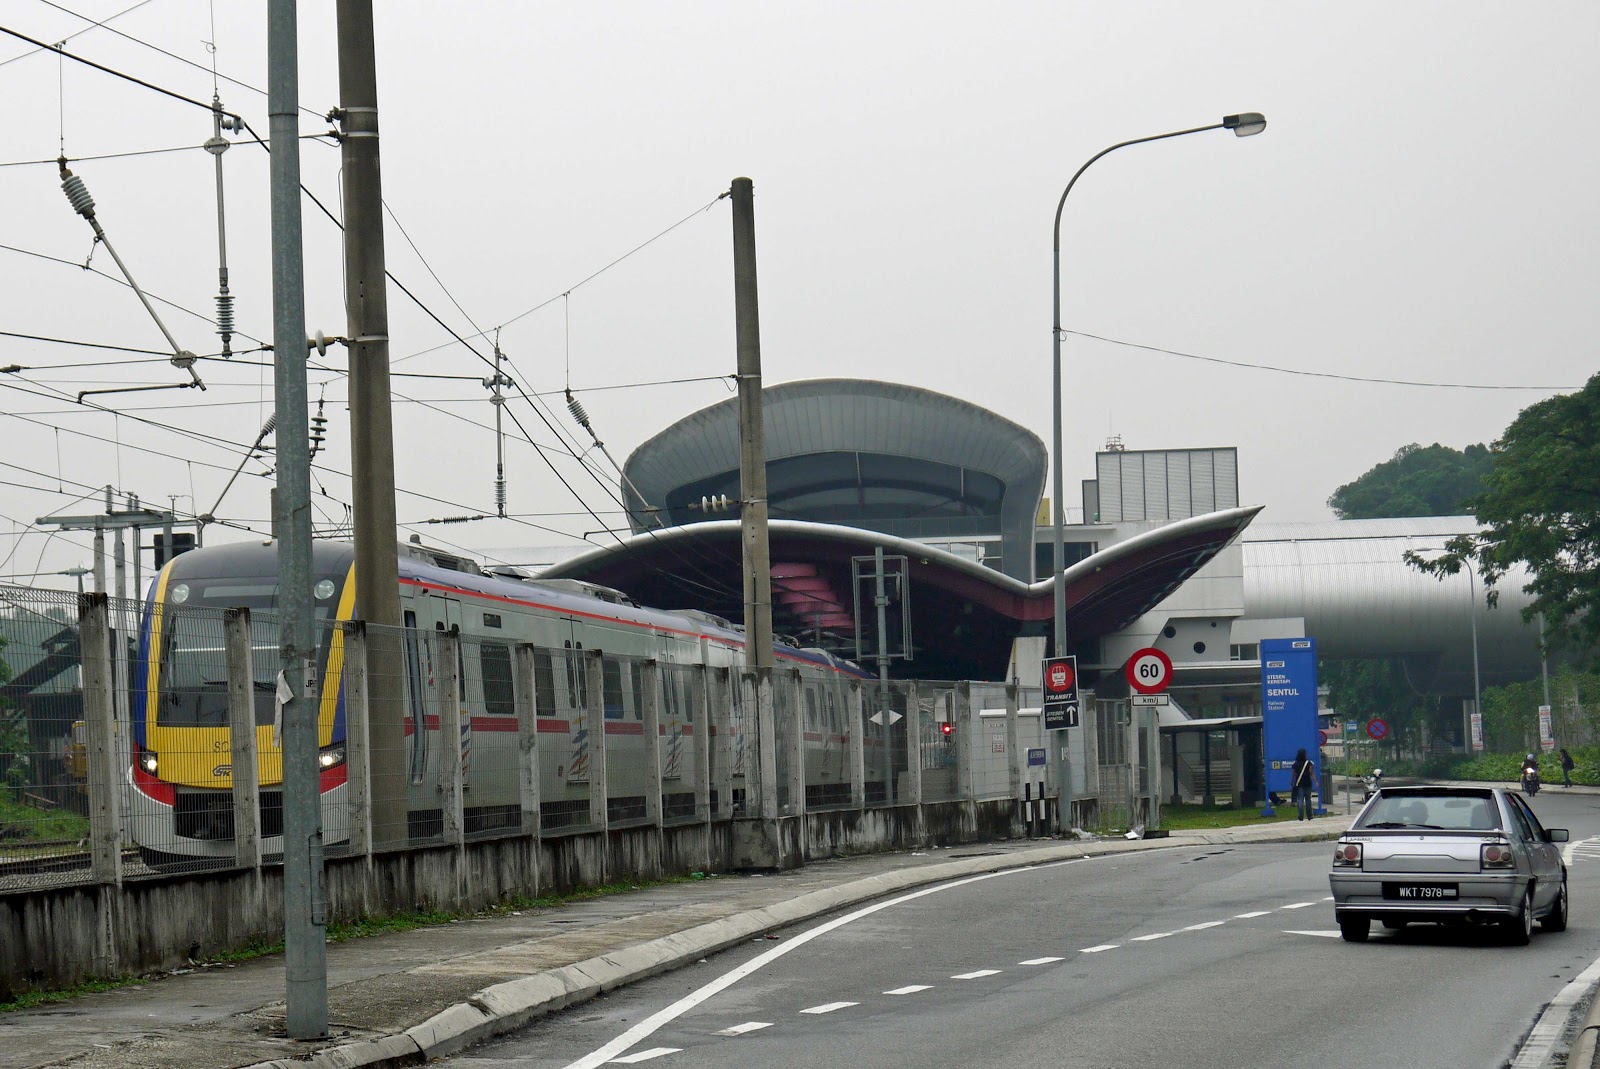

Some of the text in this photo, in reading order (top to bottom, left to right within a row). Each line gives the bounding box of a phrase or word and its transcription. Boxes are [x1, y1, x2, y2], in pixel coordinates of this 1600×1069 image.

[1140, 664, 1159, 678] 60
[1046, 693, 1072, 701] TRANSIT
[1399, 887, 1442, 897] WKT 7978
